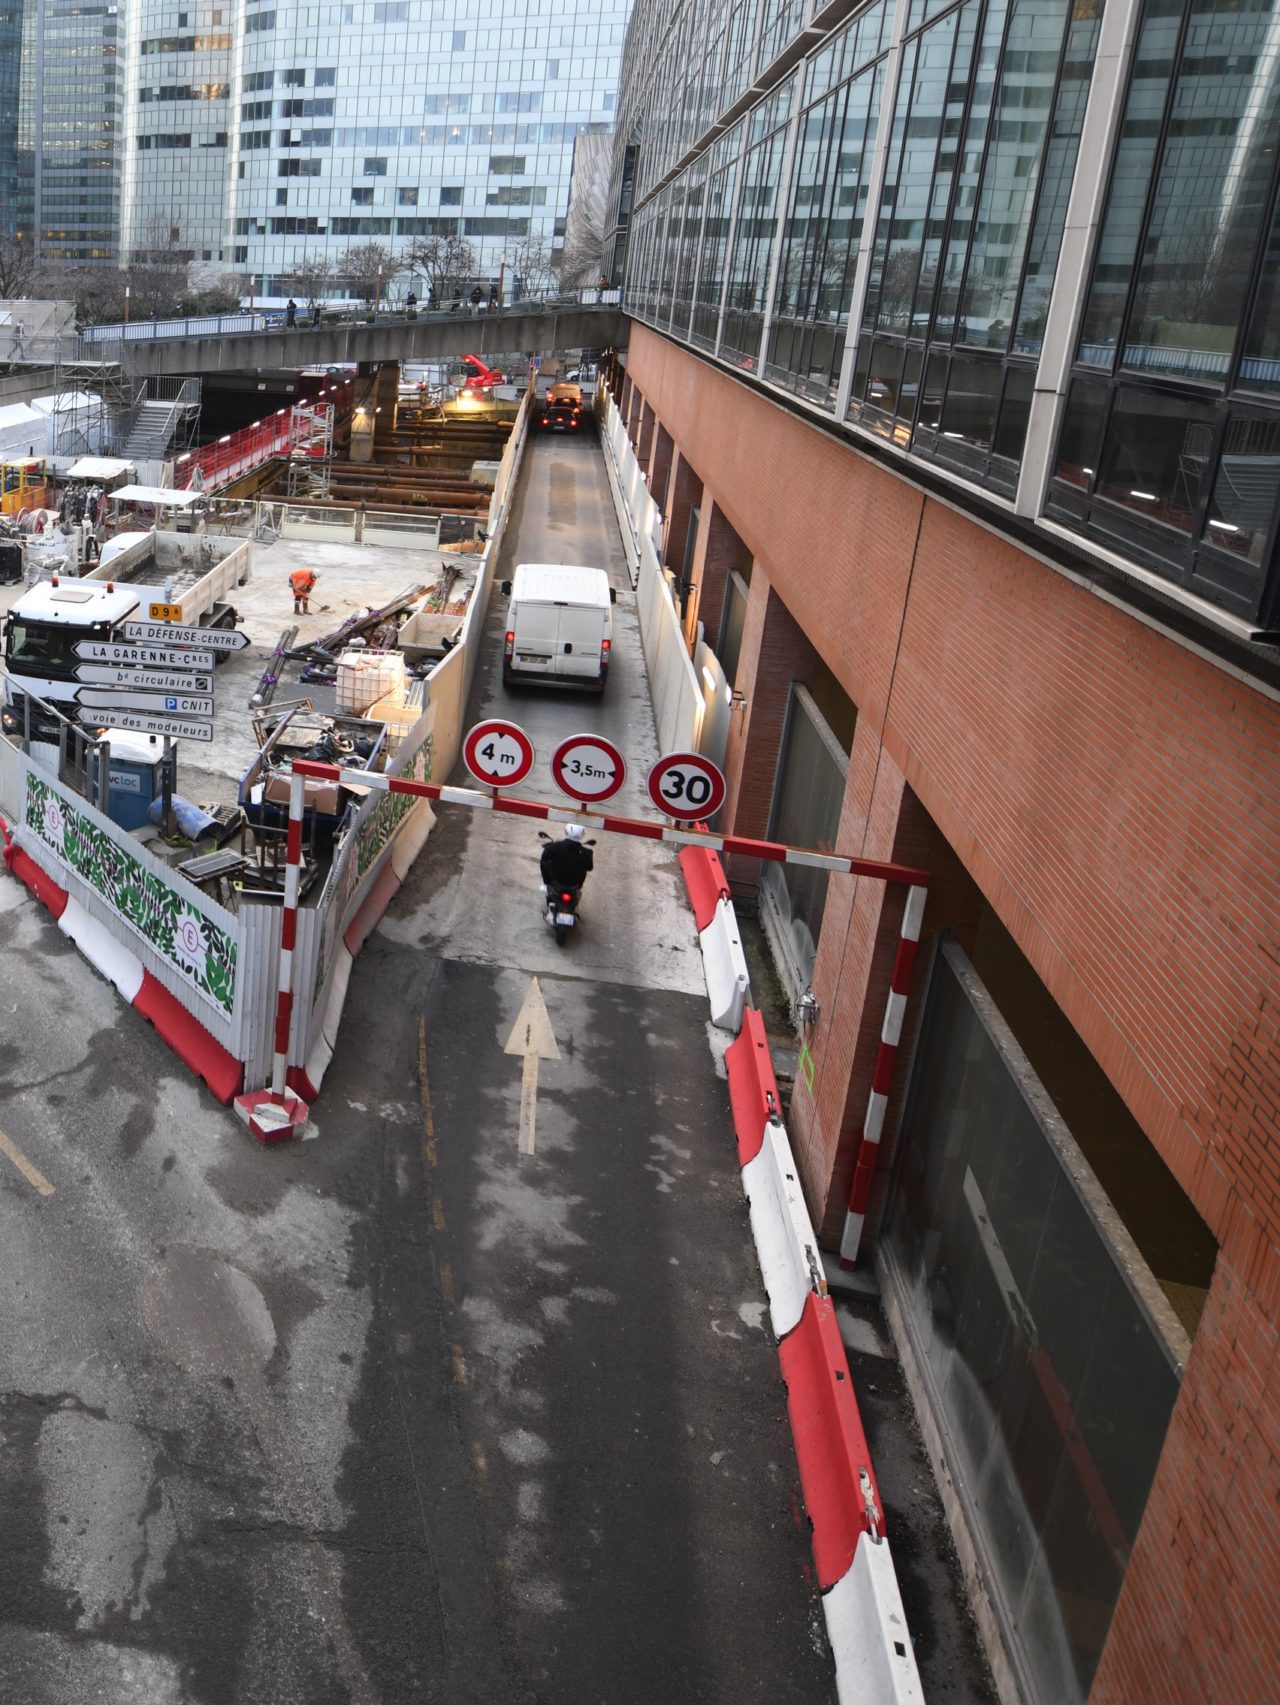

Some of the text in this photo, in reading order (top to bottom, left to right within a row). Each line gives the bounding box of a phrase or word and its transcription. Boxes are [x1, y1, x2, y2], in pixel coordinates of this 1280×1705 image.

[129, 626, 142, 637] LA
[93, 646, 107, 657] LA
[134, 674, 193, 688] circulaire
[181, 700, 210, 712] CNIT
[92, 714, 209, 737] voie des modeleurs
[481, 743, 515, 766] 4 m
[661, 770, 711, 805] 30
